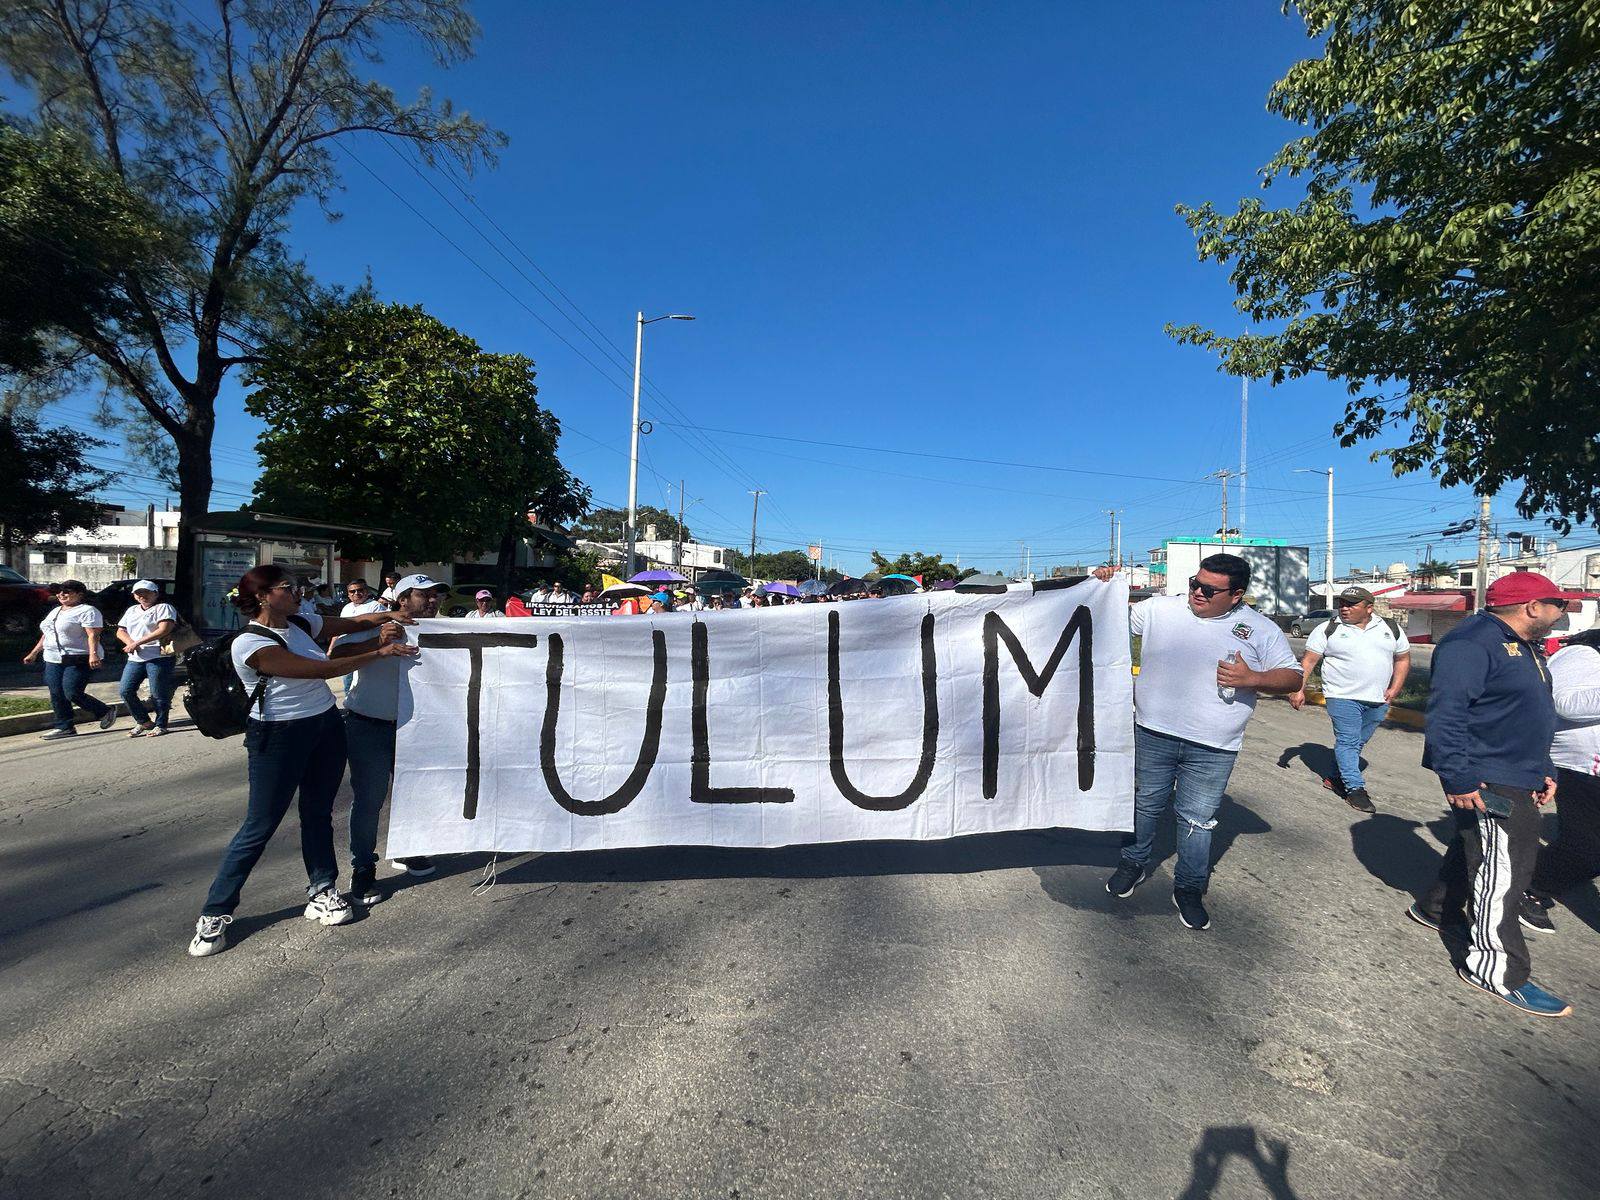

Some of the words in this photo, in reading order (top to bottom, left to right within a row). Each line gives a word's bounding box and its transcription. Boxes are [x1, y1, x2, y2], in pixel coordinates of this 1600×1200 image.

[533, 608, 553, 616] LEY
[555, 608, 575, 616] DEL
[578, 608, 612, 616] ISSSTE
[418, 605, 1096, 820] TULUM
